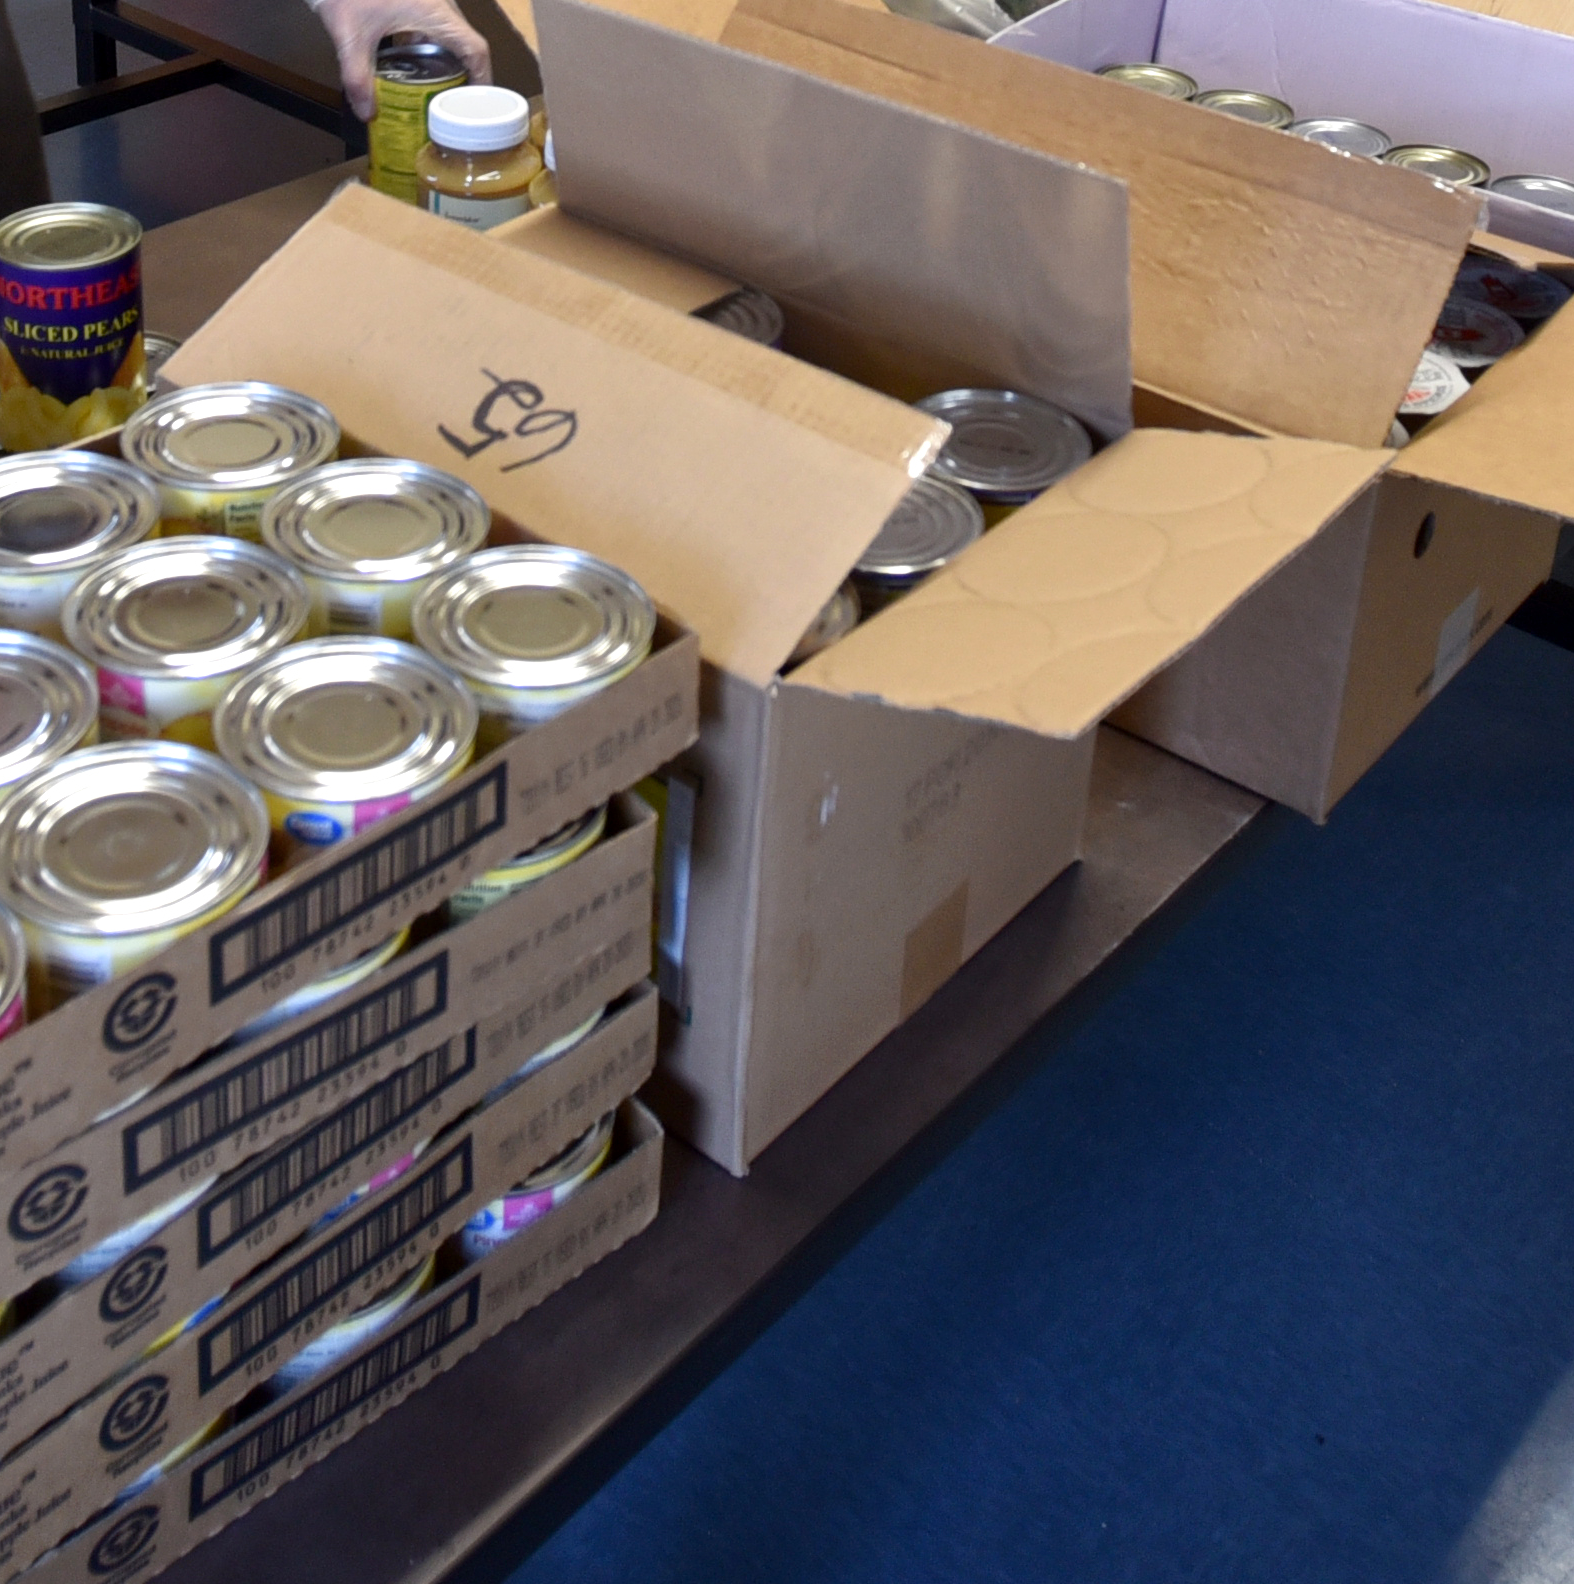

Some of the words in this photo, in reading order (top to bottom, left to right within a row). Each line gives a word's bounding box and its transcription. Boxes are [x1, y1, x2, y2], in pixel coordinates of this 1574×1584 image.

[4, 315, 79, 343] SLICED
[83, 306, 139, 340] PEARS
[262, 962, 296, 993] 100
[179, 1149, 216, 1184] 100
[234, 1101, 301, 1152] 78742
[244, 1217, 278, 1252] 100
[244, 1345, 278, 1377] 100
[235, 1471, 271, 1503] 100
